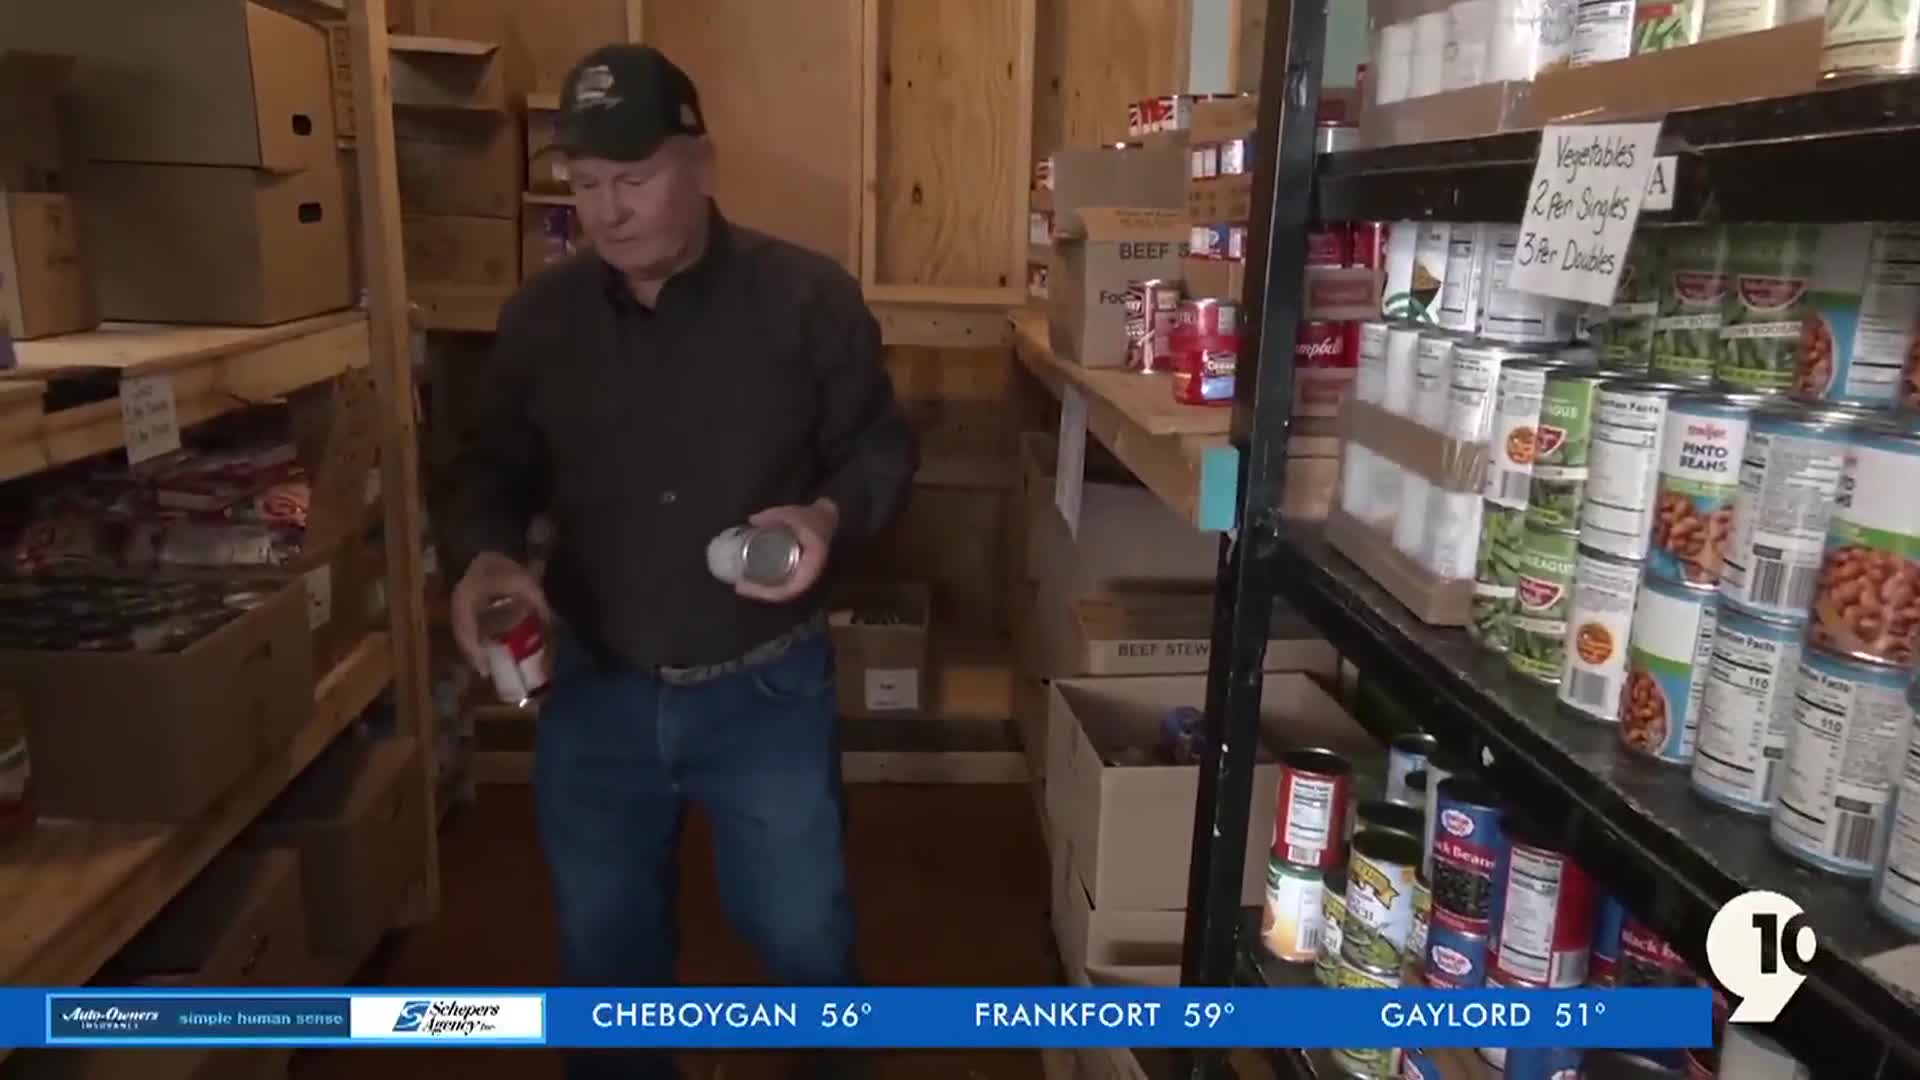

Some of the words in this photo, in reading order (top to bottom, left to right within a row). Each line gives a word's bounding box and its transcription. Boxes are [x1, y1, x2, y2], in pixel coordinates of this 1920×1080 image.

[1556, 135, 1636, 184] Vegetables
[1648, 162, 1667, 195] A
[1531, 179, 1549, 216] 2
[1547, 191, 1573, 221] Per
[1576, 186, 1630, 235] Singles
[1119, 242, 1169, 260] BEEF
[1519, 232, 1536, 267] 3
[1534, 237, 1557, 264] Per
[1561, 239, 1616, 275] Doubles
[1682, 442, 1729, 458] PINTO
[1679, 455, 1729, 472] BEANS
[1746, 636, 1776, 652] Facts
